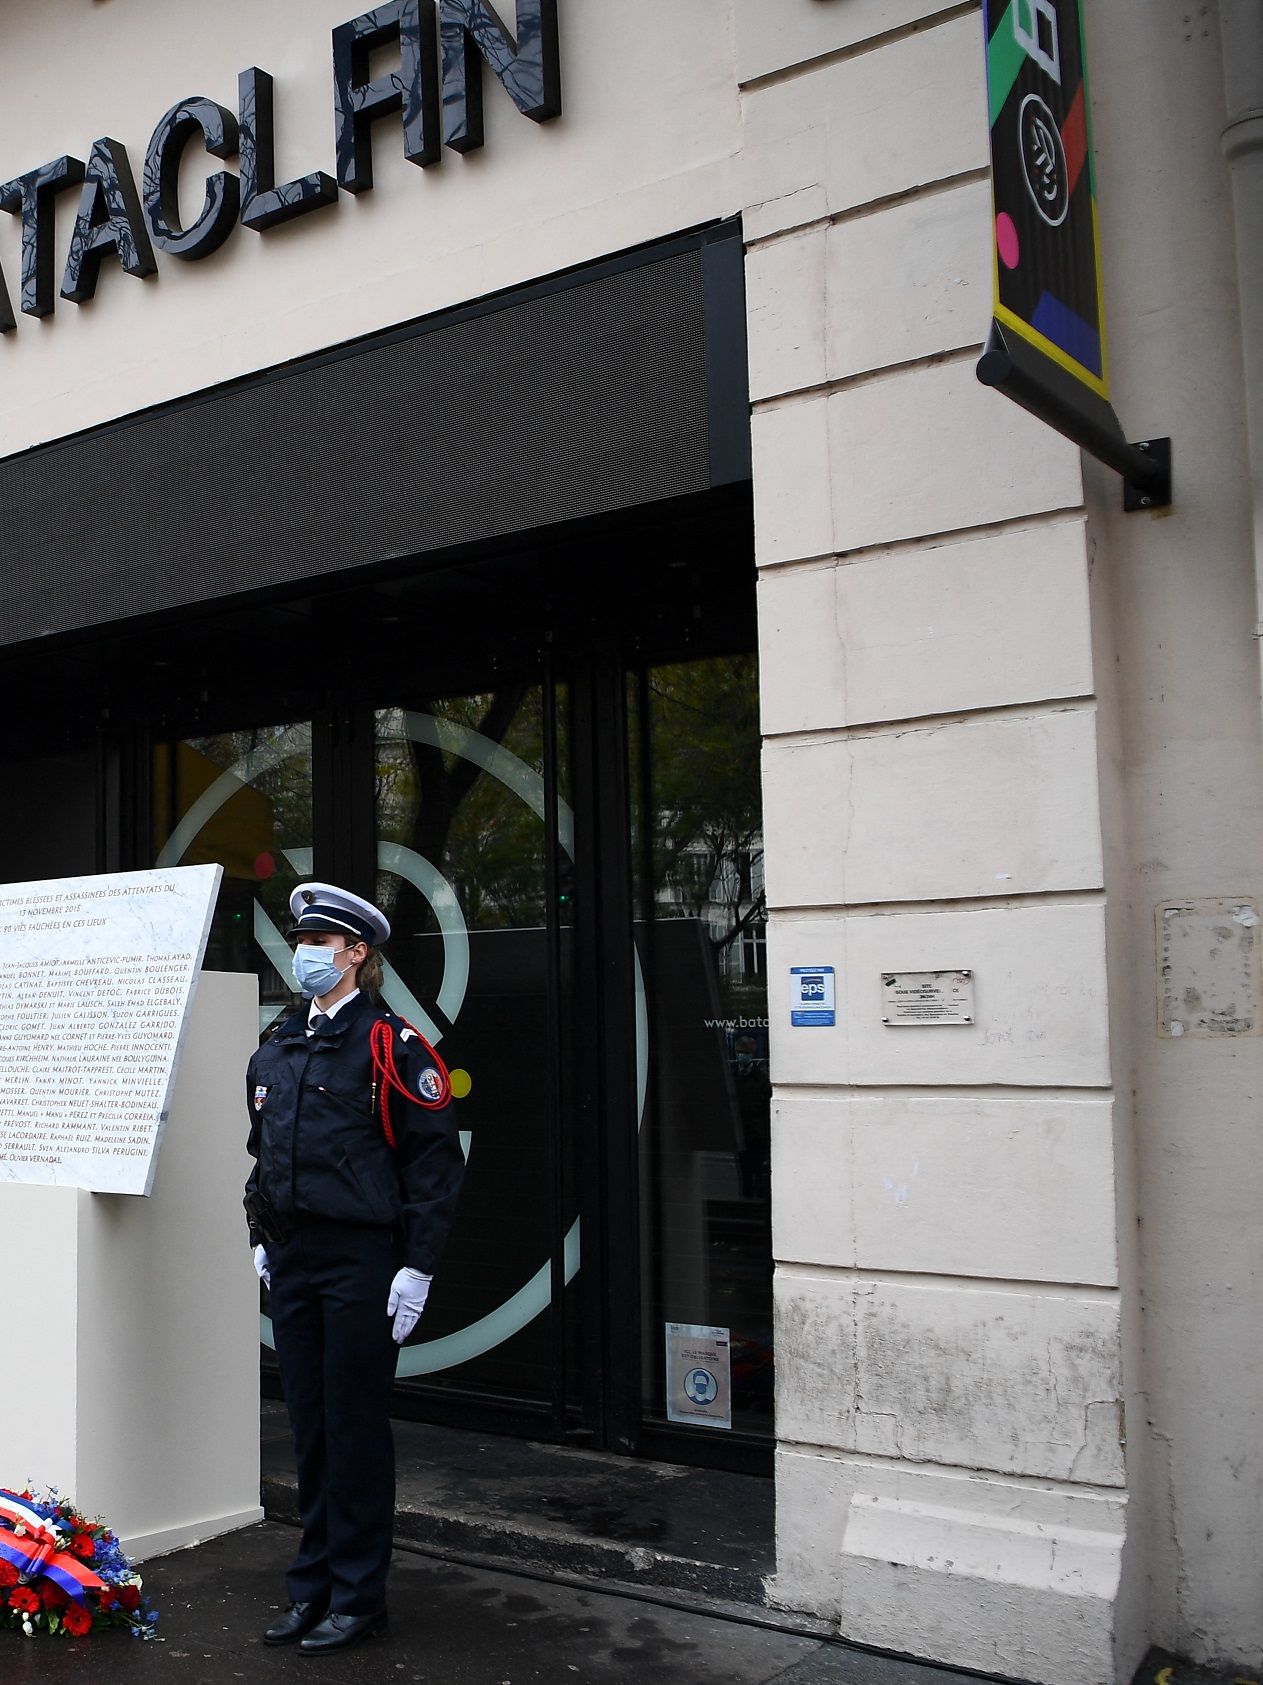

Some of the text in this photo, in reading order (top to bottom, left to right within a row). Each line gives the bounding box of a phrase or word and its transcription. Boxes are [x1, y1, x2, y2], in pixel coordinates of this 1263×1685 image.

[107, 888, 121, 897] DES
[121, 885, 162, 896] ATTENTATS
[26, 906, 62, 915] NOVEMBRE
[61, 920, 72, 928] EN
[72, 919, 85, 927] CES
[801, 984, 825, 997] eps
